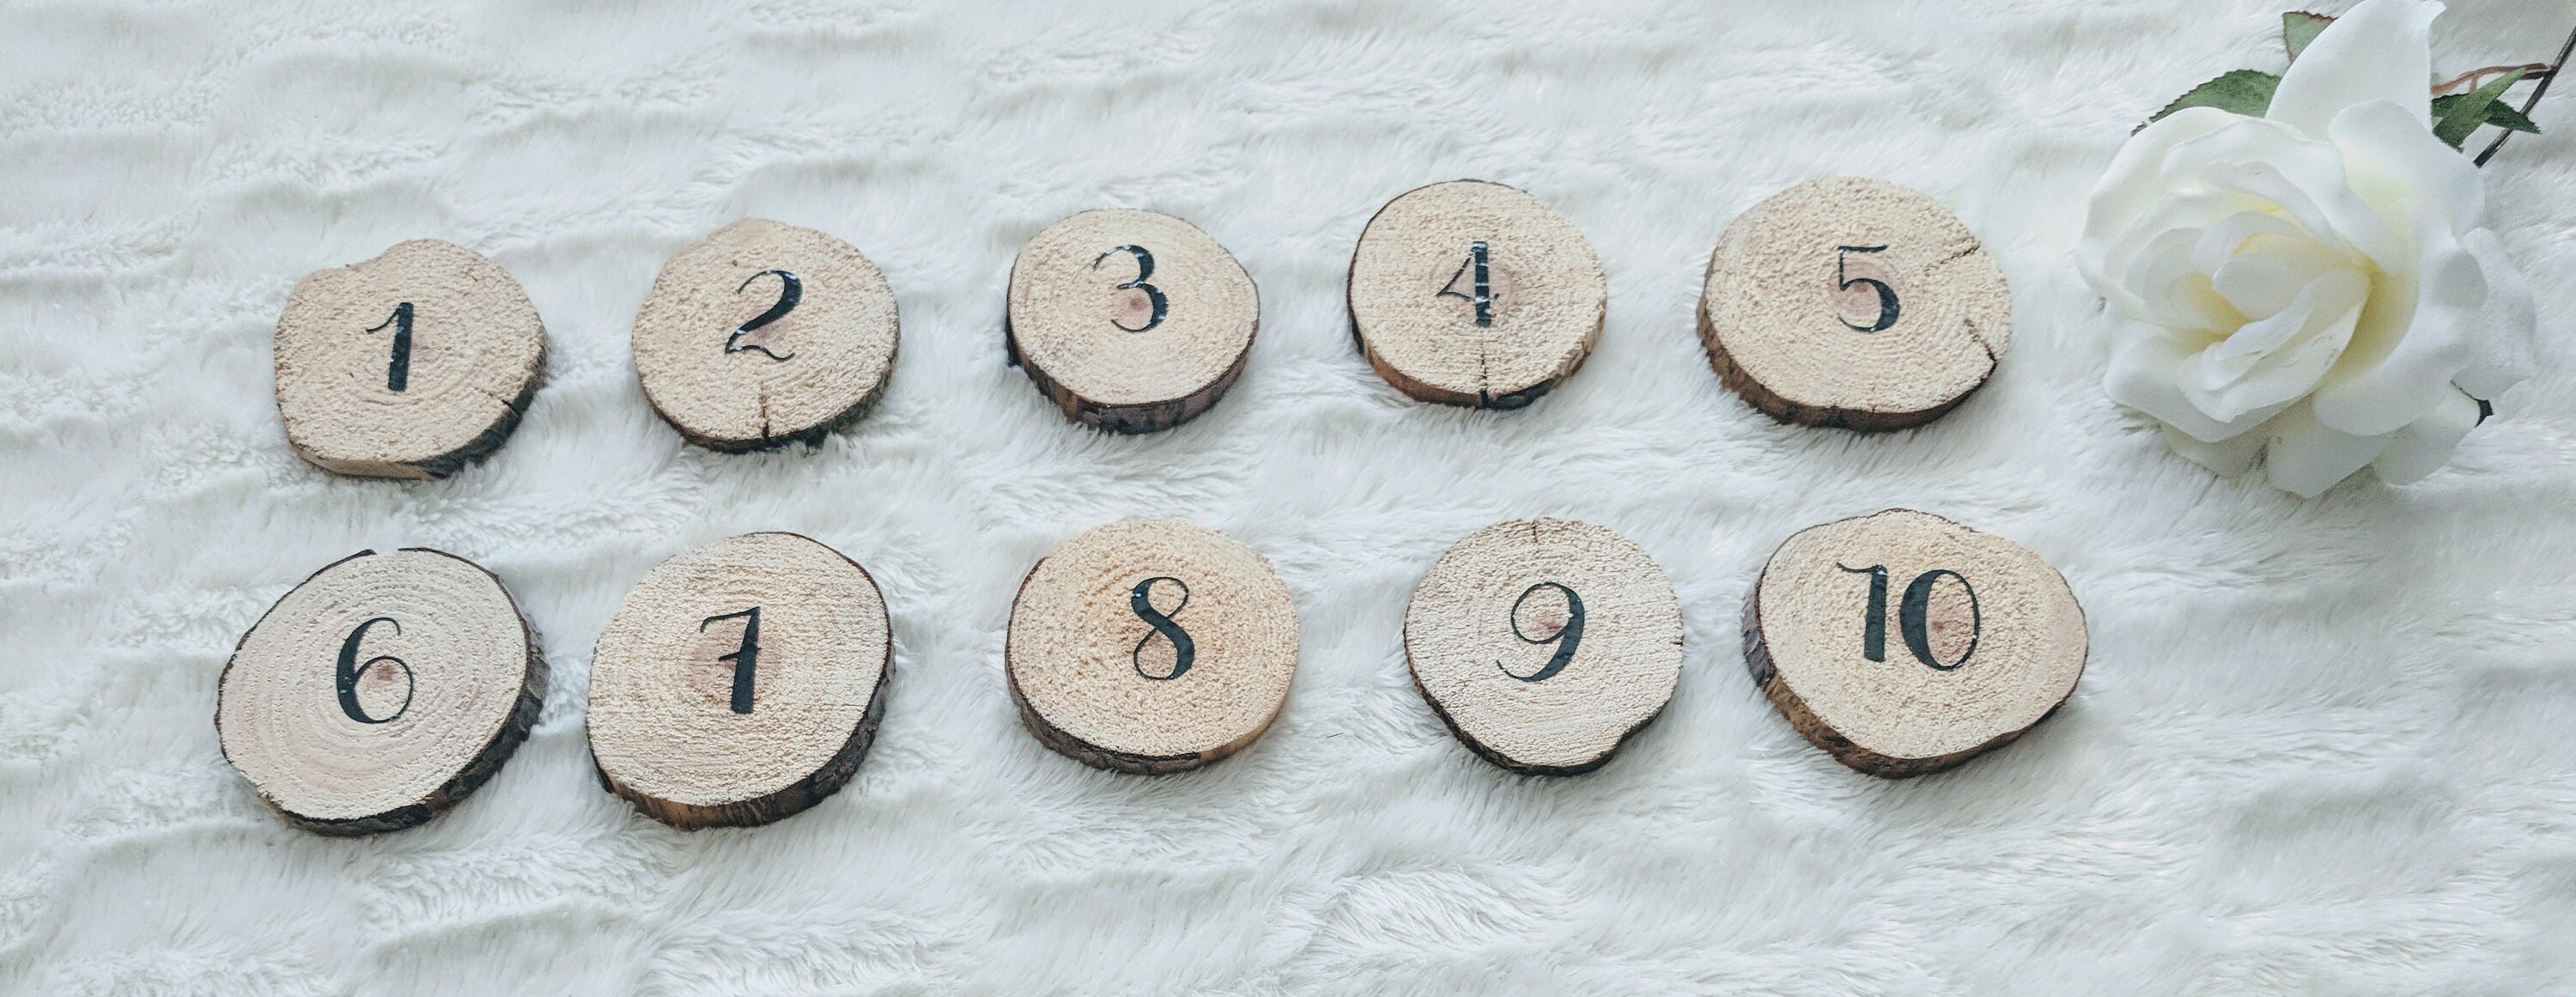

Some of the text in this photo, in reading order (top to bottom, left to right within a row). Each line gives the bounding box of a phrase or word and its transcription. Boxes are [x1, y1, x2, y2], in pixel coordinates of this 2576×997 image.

[724, 269, 802, 362] 2
[1092, 244, 1169, 333] 3
[1436, 240, 1500, 328] 4
[1837, 244, 1901, 333] 5
[365, 301, 415, 392] 1
[699, 605, 762, 715] 7
[1129, 576, 1196, 682] 8
[1496, 581, 1587, 683] 9
[1836, 562, 1982, 672] 10
[335, 617, 415, 725] 6
